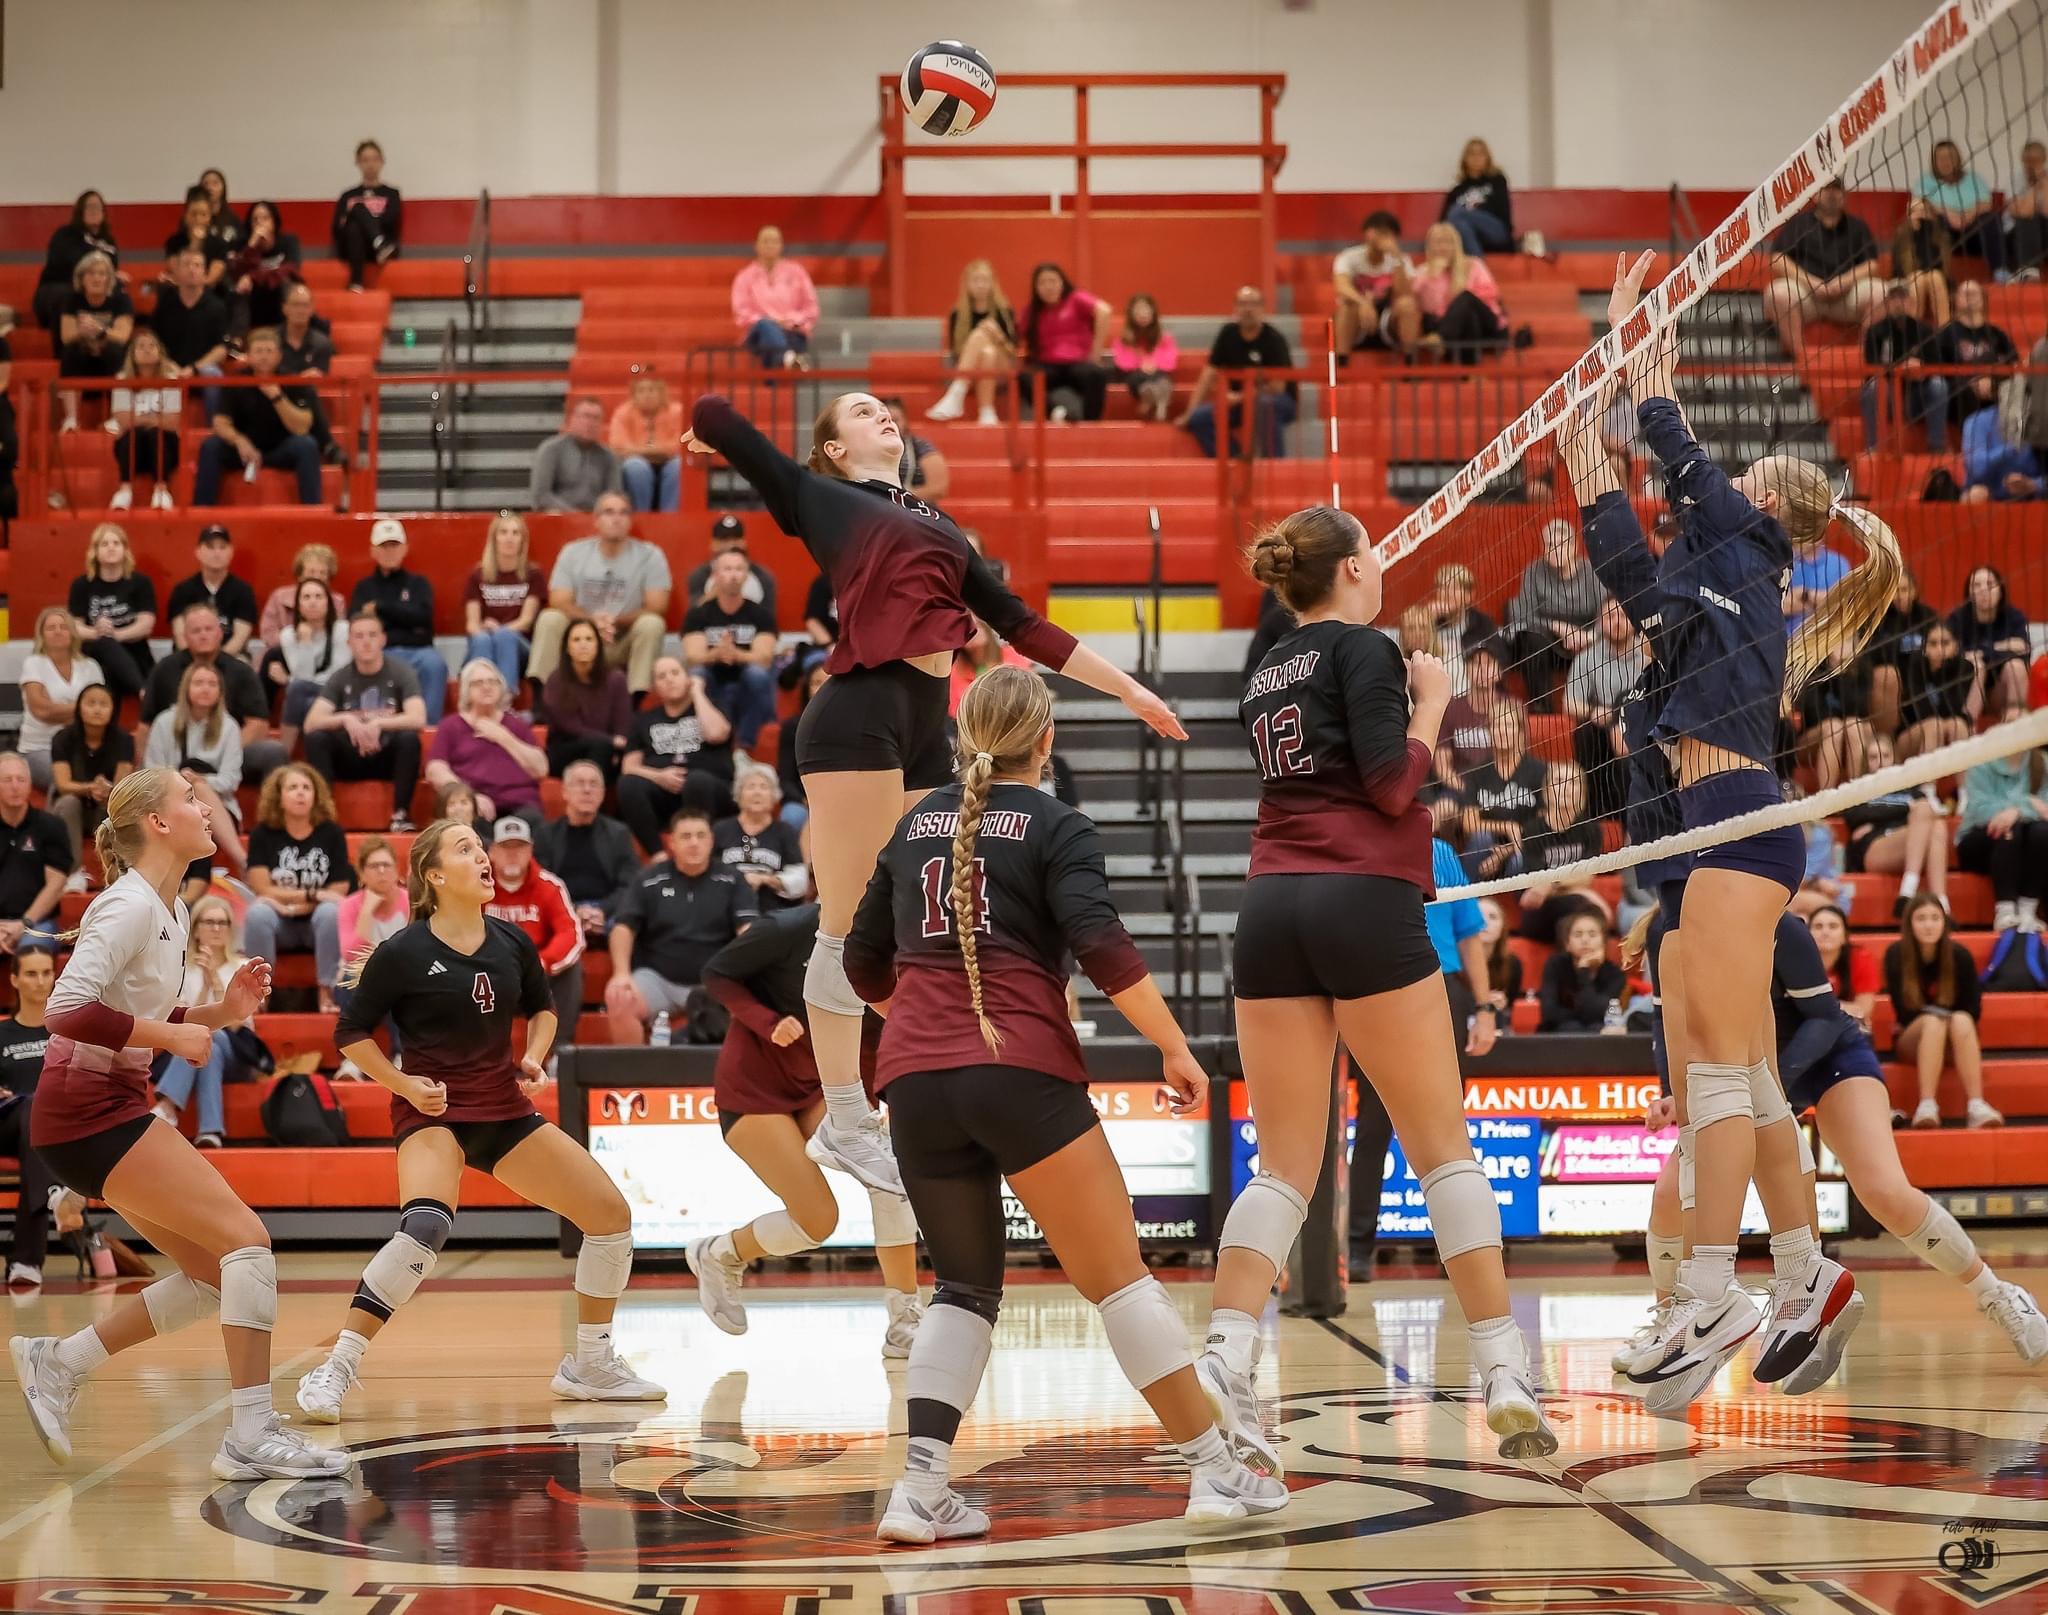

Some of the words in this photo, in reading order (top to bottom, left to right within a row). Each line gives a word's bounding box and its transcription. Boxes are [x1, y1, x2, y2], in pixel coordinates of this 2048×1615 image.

[945, 55, 990, 89] Manual
[1251, 702, 1314, 781] 12
[906, 810, 1032, 841] ASSUTION
[920, 856, 992, 938] 14
[471, 971, 496, 1014] 4
[1463, 1084, 1588, 1110] MANUAL
